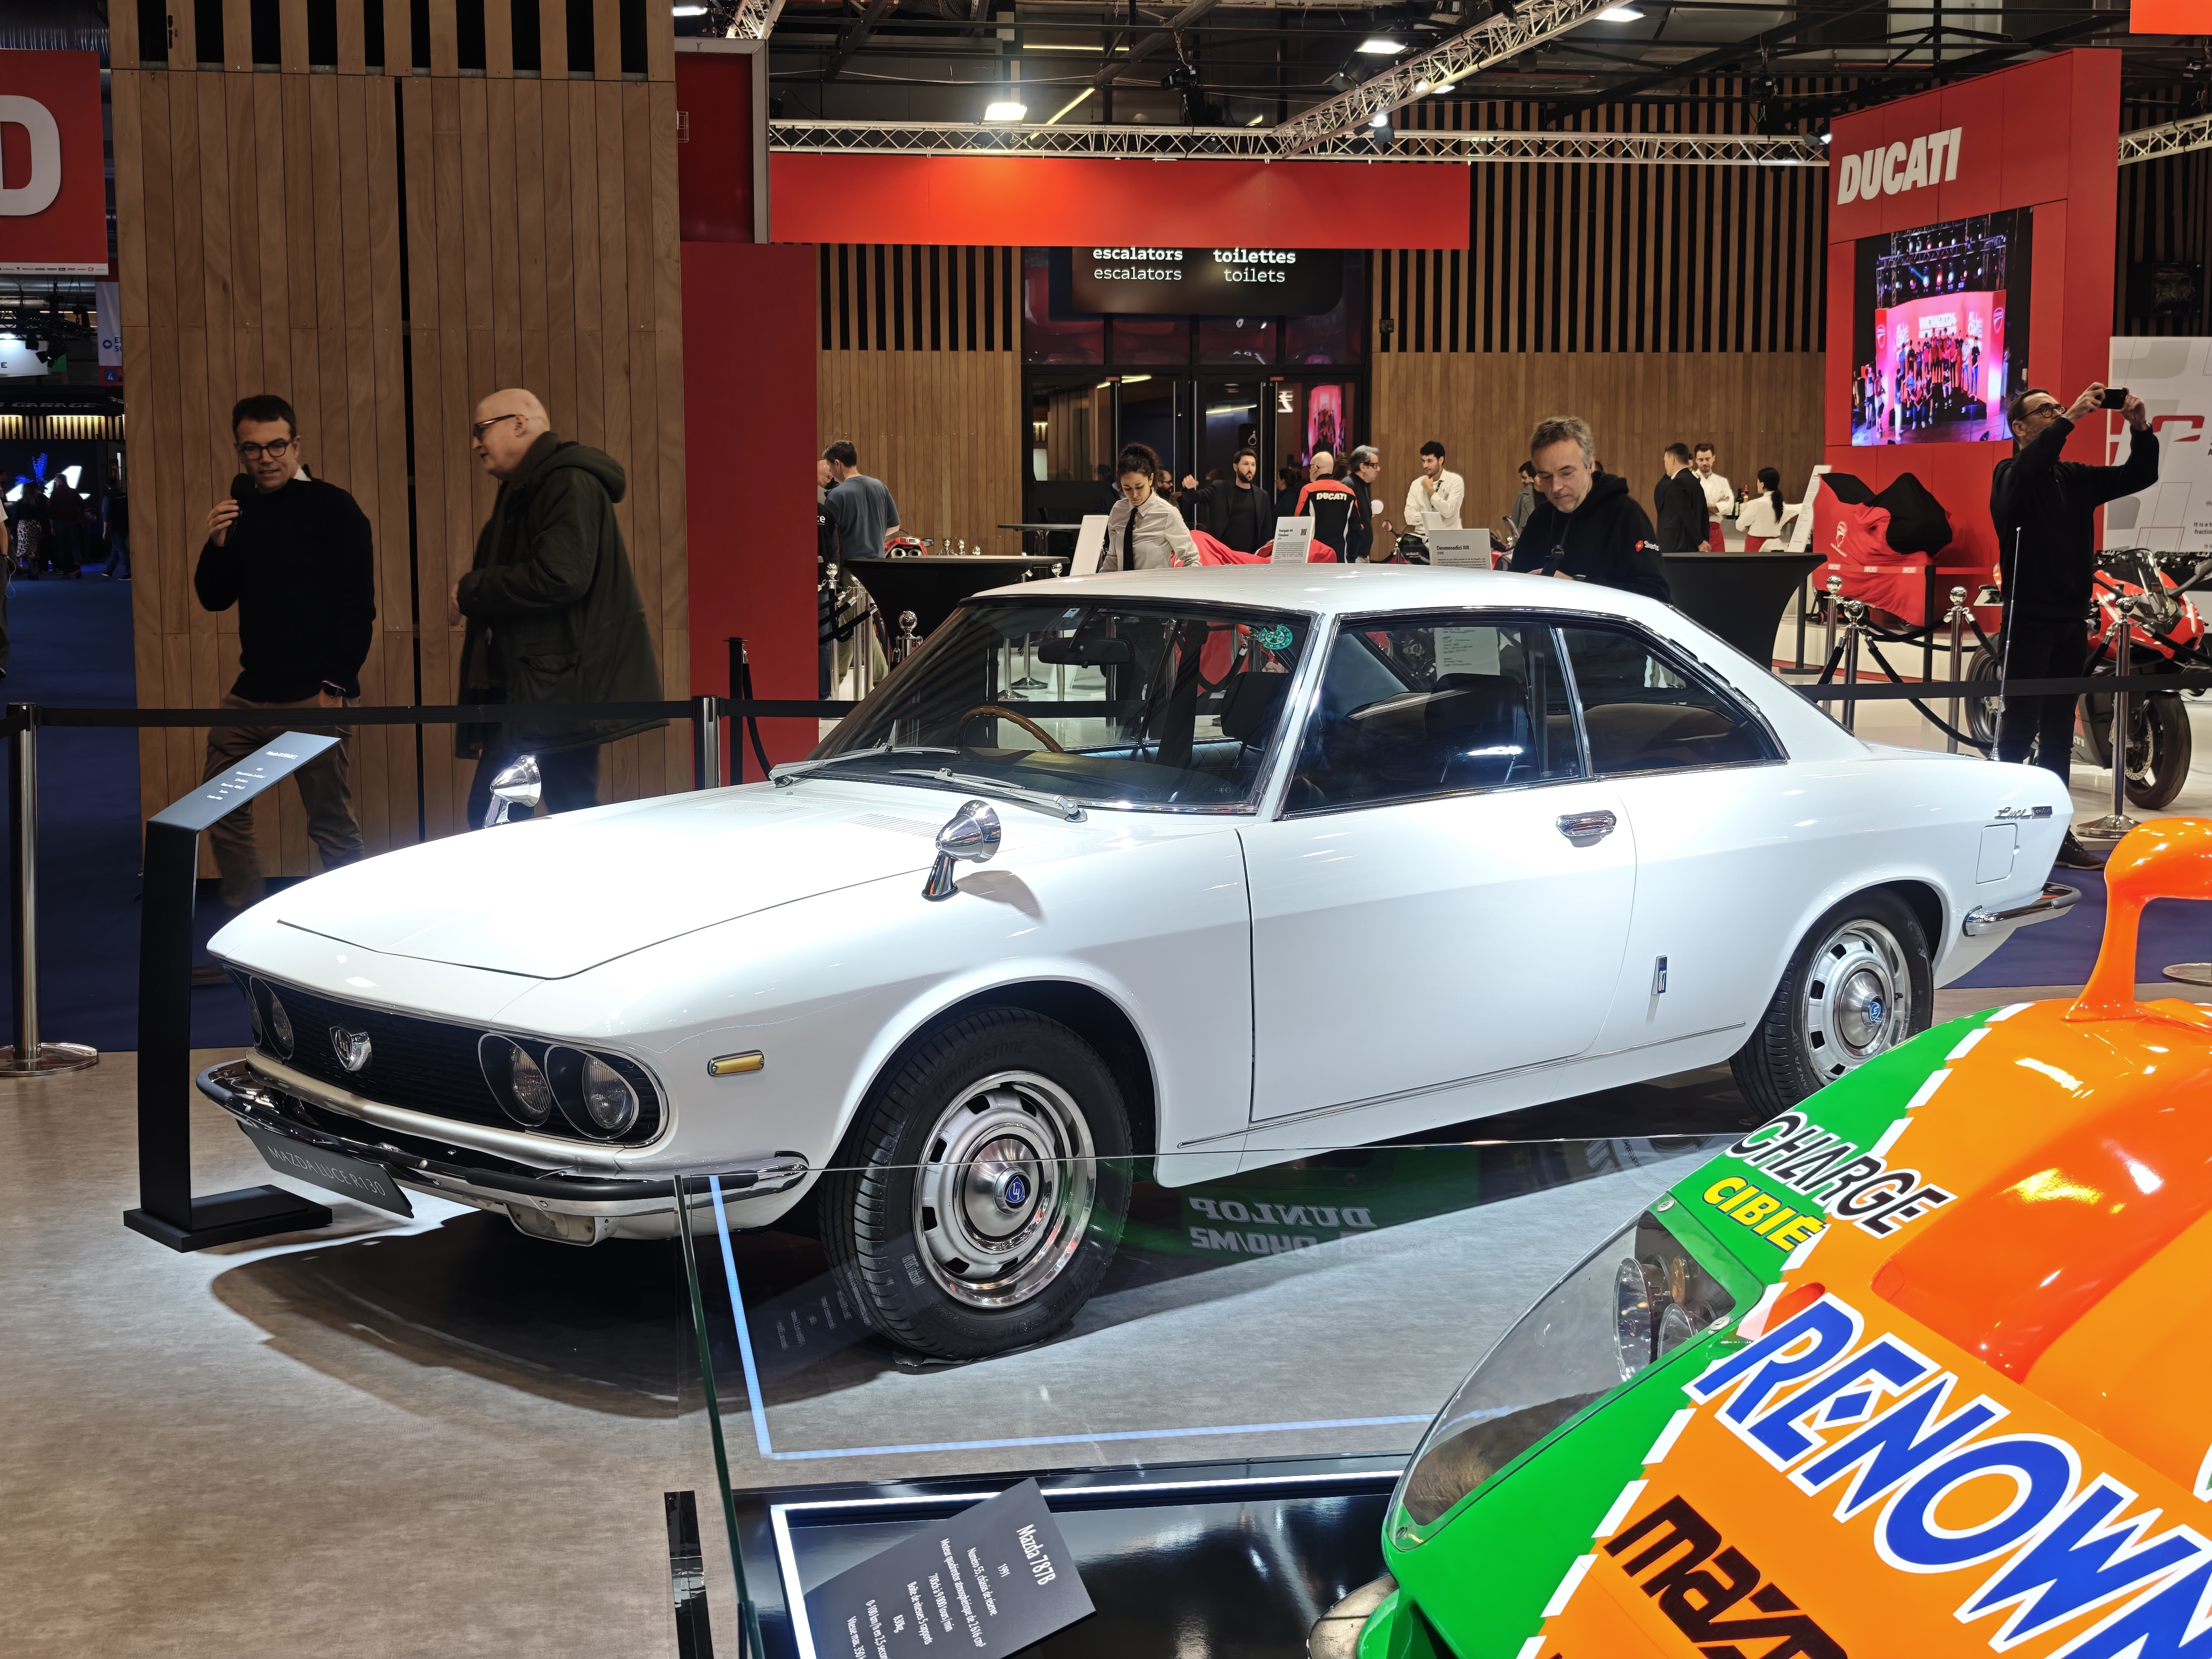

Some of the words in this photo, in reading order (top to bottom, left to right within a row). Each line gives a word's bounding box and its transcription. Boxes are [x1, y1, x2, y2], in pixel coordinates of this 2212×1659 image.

[0, 95, 61, 216] D
[1837, 127, 1963, 205] DUCATI
[1093, 246, 1183, 260] escalators
[1213, 247, 1296, 264] toilettes
[1094, 266, 1182, 280] escalators
[1224, 268, 1285, 282] toilets
[1317, 492, 1347, 501] DUCATI
[267, 1145, 318, 1174] MAZDA
[320, 1164, 352, 1184] LUCE
[349, 1173, 386, 1196] R130
[1726, 1112, 1957, 1238] CHARGE
[1702, 1176, 1826, 1253] CIBIÉ
[940, 1538, 952, 1556] Moteur
[1016, 1523, 1043, 1559] Mazda
[967, 1547, 981, 1568] Numéro
[944, 1555, 961, 1581] quadrirotor
[997, 1563, 1010, 1577] 1991
[1029, 1554, 1056, 1585] 787B
[928, 1573, 941, 1590] 700ch
[977, 1575, 990, 1593] châssis
[954, 1581, 972, 1616] atmosphérique
[983, 1591, 993, 1599] de
[866, 1600, 878, 1616] 0-100
[907, 1581, 918, 1596] Boîte
[913, 1601, 925, 1620] vitesses
[919, 1623, 933, 1644] rapports
[985, 1597, 997, 1616] réserve
[847, 1616, 857, 1635] Vitesse
[869, 1614, 882, 1630] km/h
[893, 1614, 906, 1633] 830kg
[966, 1615, 976, 1623] de
[851, 1634, 860, 1647] max.
[874, 1635, 886, 1645] 2,5
[854, 1645, 865, 1657] 350
